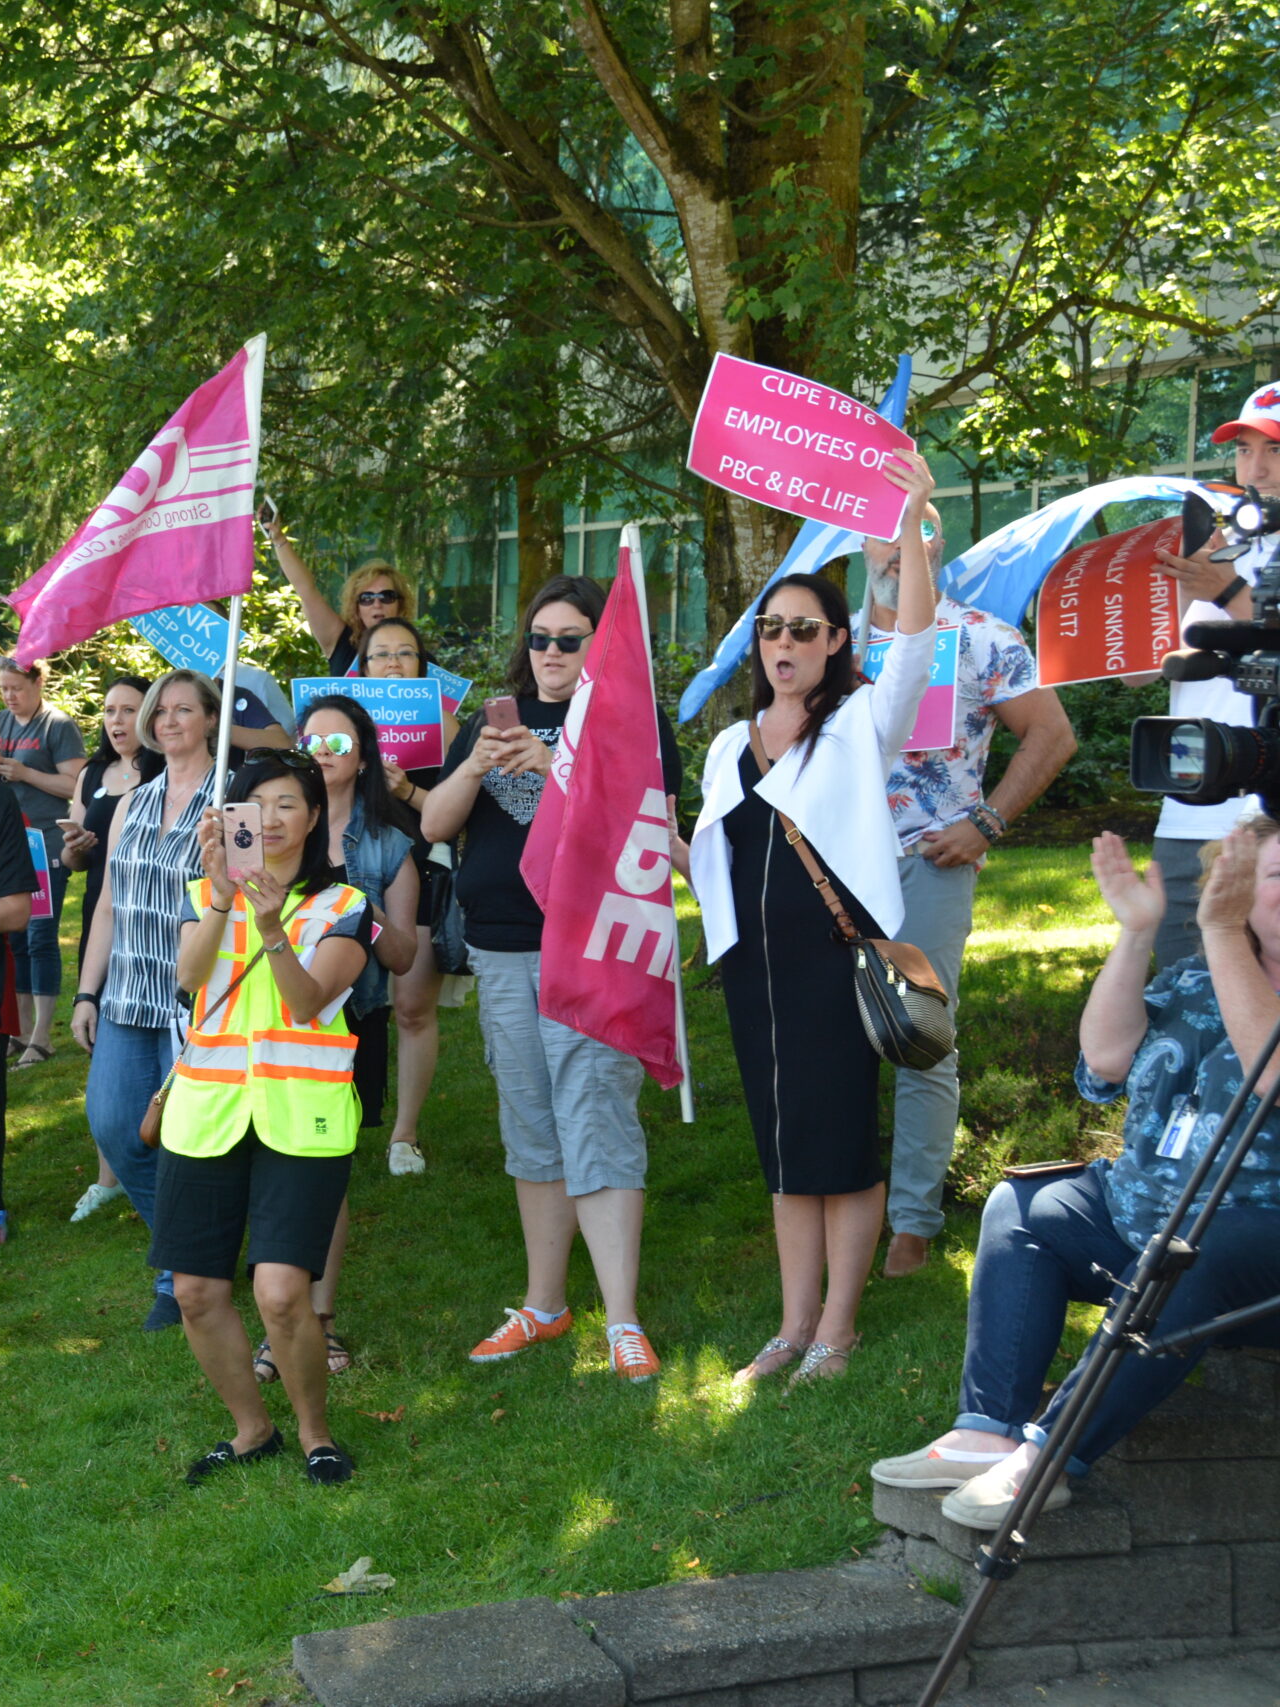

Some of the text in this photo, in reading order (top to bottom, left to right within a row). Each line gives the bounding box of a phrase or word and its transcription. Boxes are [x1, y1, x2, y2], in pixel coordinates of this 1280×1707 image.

[761, 375, 877, 426] CUPE 1816
[724, 407, 893, 471] EMPLOYEES OF
[719, 455, 869, 519] PBC & BC LIFE
[1060, 592, 1078, 608] IS
[1060, 613, 1078, 637] IT?
[1104, 593, 1125, 671] SINKING
[1149, 572, 1171, 665] HRIVING...
[179, 633, 220, 667] OUR
[300, 683, 432, 700] Pacific Blue Cross,
[366, 705, 419, 725] ployer
[377, 728, 427, 743] abour
